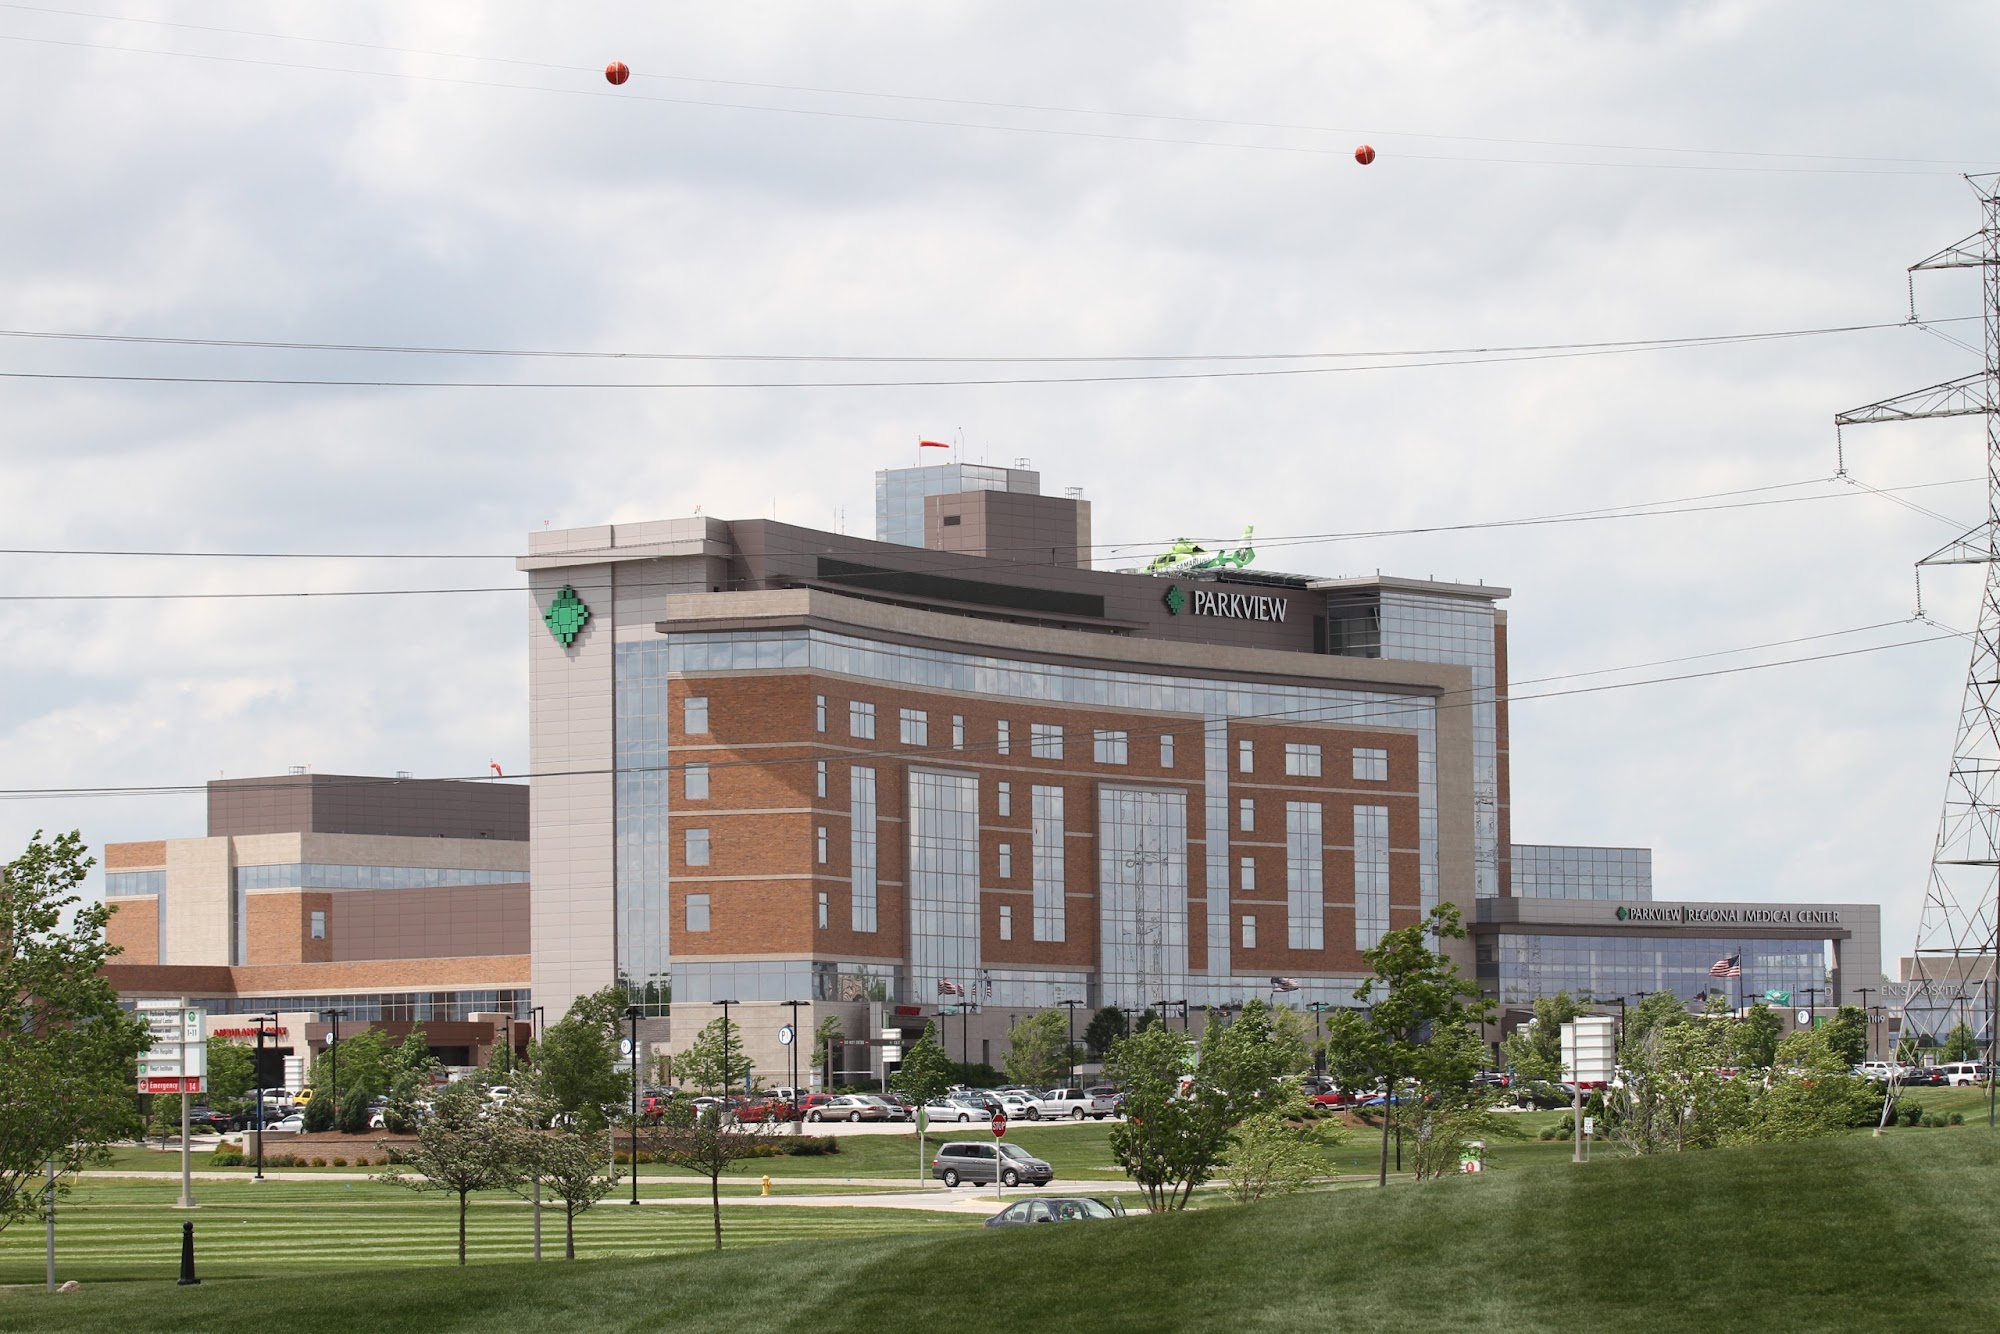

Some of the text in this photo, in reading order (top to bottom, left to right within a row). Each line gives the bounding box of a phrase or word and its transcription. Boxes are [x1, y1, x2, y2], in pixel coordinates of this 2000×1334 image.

[1194, 590, 1288, 623] PARKVIEW
[1629, 907, 1841, 923] PARKVIEW REGIONAL MEDICAL CENTER
[149, 1081, 196, 1091] Emergency 14
[993, 1121, 1006, 1130] STOP
